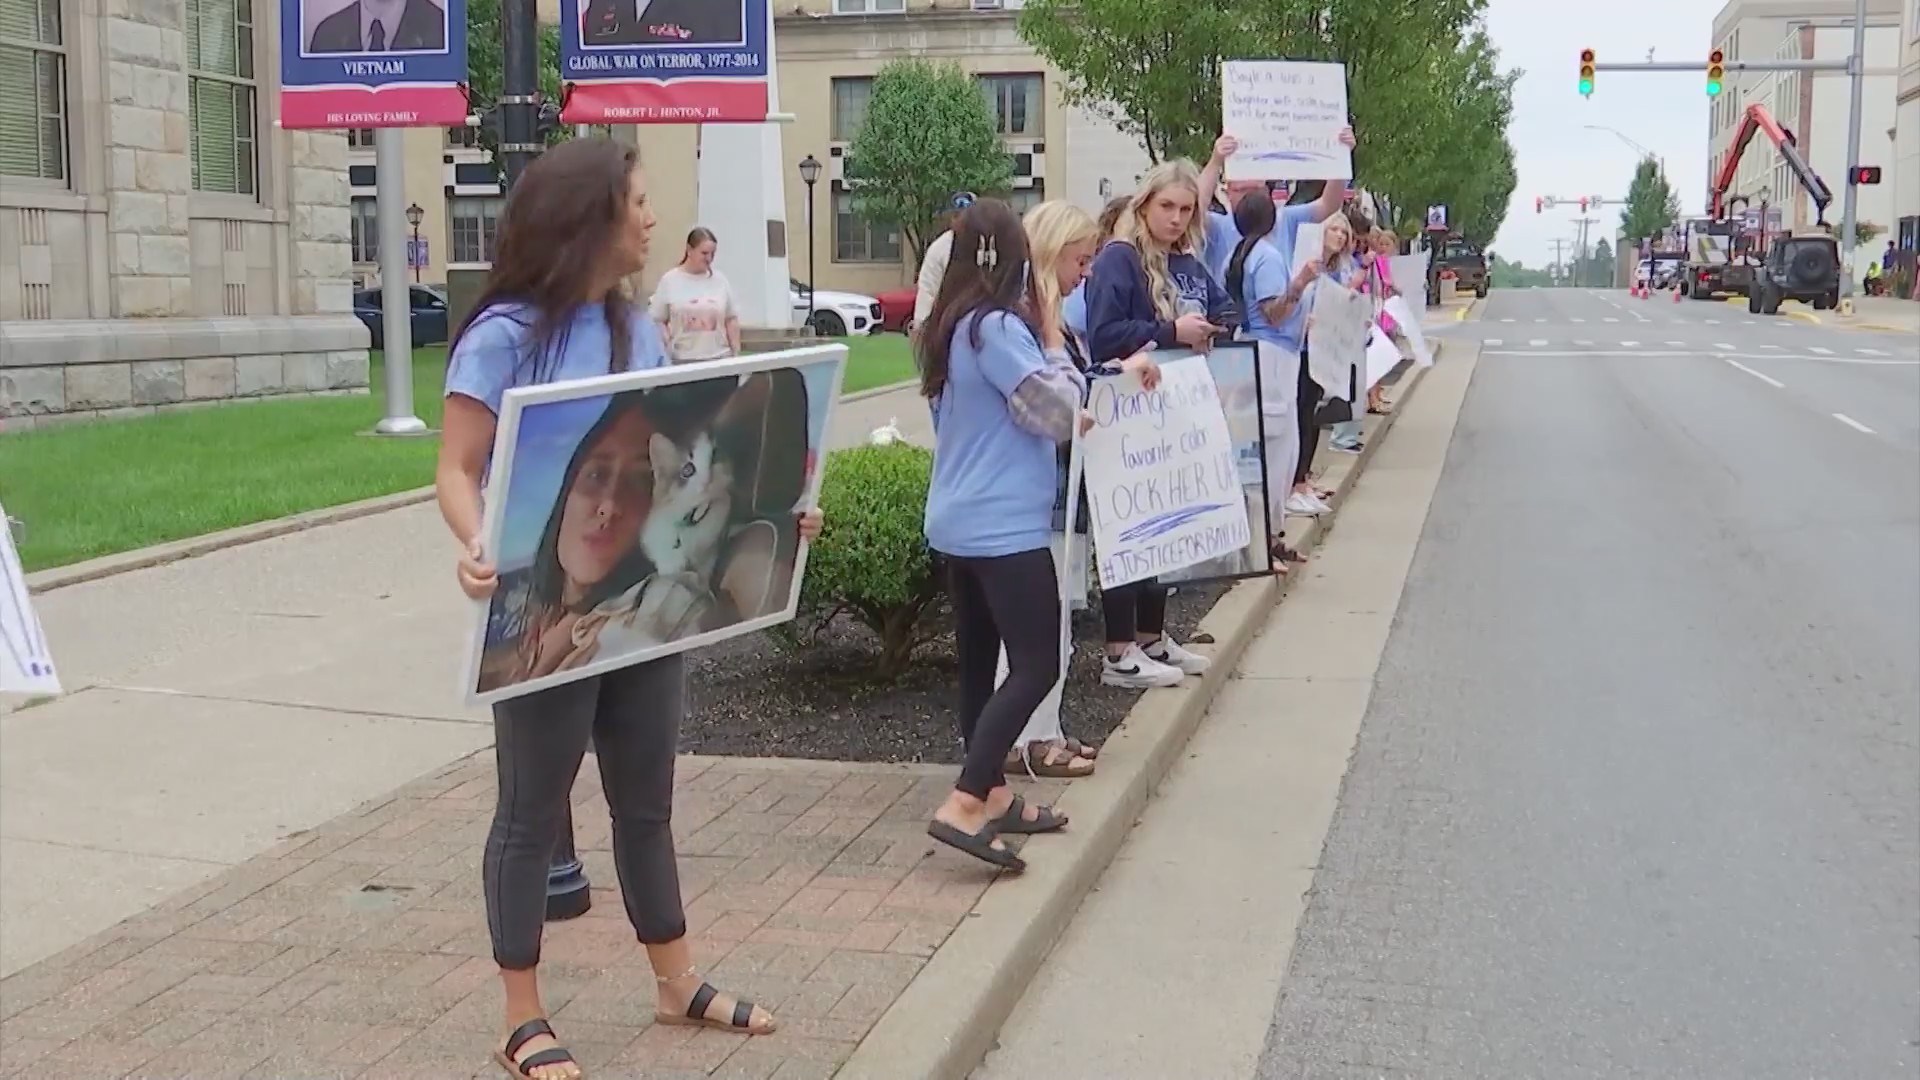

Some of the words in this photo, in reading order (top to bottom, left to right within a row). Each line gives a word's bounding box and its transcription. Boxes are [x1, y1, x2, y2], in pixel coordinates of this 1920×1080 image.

[343, 60, 405, 75] VIETNAM
[568, 55, 613, 70] GLOBAL
[613, 55, 639, 69] WAR
[640, 54, 656, 68] ON
[658, 53, 706, 70] TERROR,
[707, 52, 760, 67] 1977-2014
[326, 112, 344, 123] HIS
[346, 112, 382, 123] LOVING
[383, 111, 419, 122] FAMILY
[604, 107, 646, 118] ROBERT
[648, 107, 658, 118] L.
[660, 107, 705, 119] HINTON,
[1095, 383, 1173, 430] Orange
[1120, 433, 1173, 470] favorite
[1179, 421, 1209, 455] color
[1092, 478, 1164, 530] LOCK
[1168, 462, 1208, 506] HER
